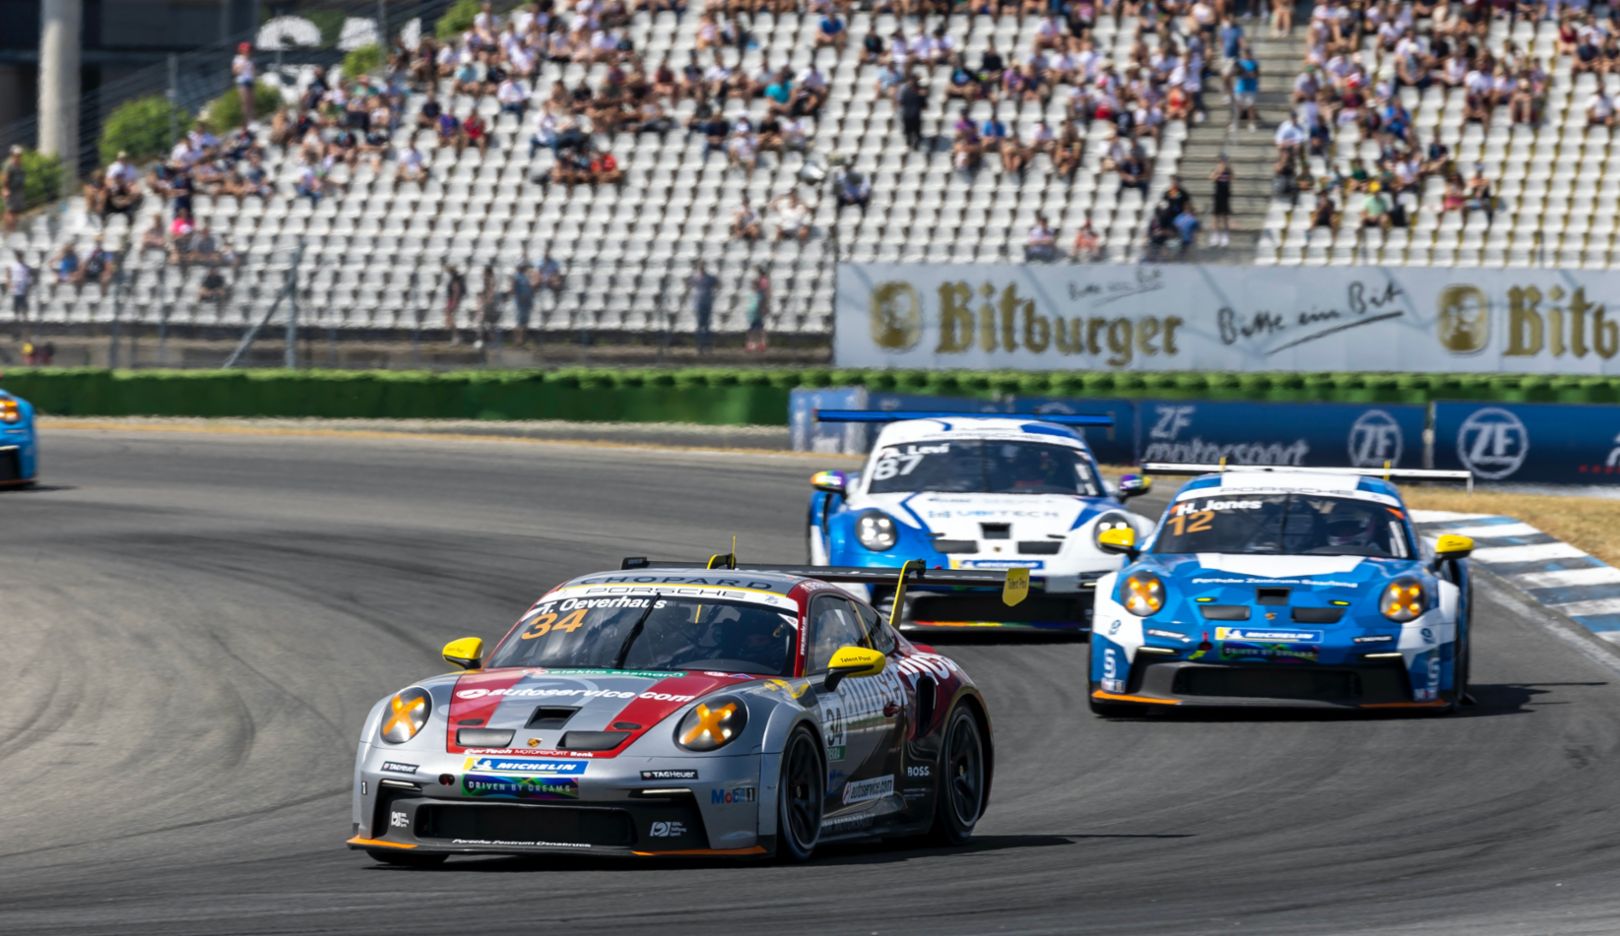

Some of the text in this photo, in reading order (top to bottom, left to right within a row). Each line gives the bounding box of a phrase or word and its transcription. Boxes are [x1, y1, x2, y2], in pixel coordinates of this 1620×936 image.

[936, 280, 1183, 366] Bitburger
[1217, 306, 1285, 345] Bitte
[1348, 277, 1404, 315] Bit
[1150, 406, 1195, 439] ZF
[1144, 440, 1308, 466] motorsport
[1469, 422, 1521, 464] ZF
[1204, 500, 1263, 511] Jones
[1168, 510, 1215, 536] 12
[580, 576, 772, 591] CHOPARD
[586, 587, 746, 601] PORSCHE
[541, 596, 667, 615] T. Oeverhaus
[522, 608, 588, 640] 34
[825, 707, 842, 746] 34
[497, 761, 576, 771] MICHELIN
[907, 766, 930, 777] BOSS
[468, 780, 571, 793] DRIVEN BY DREAMS
